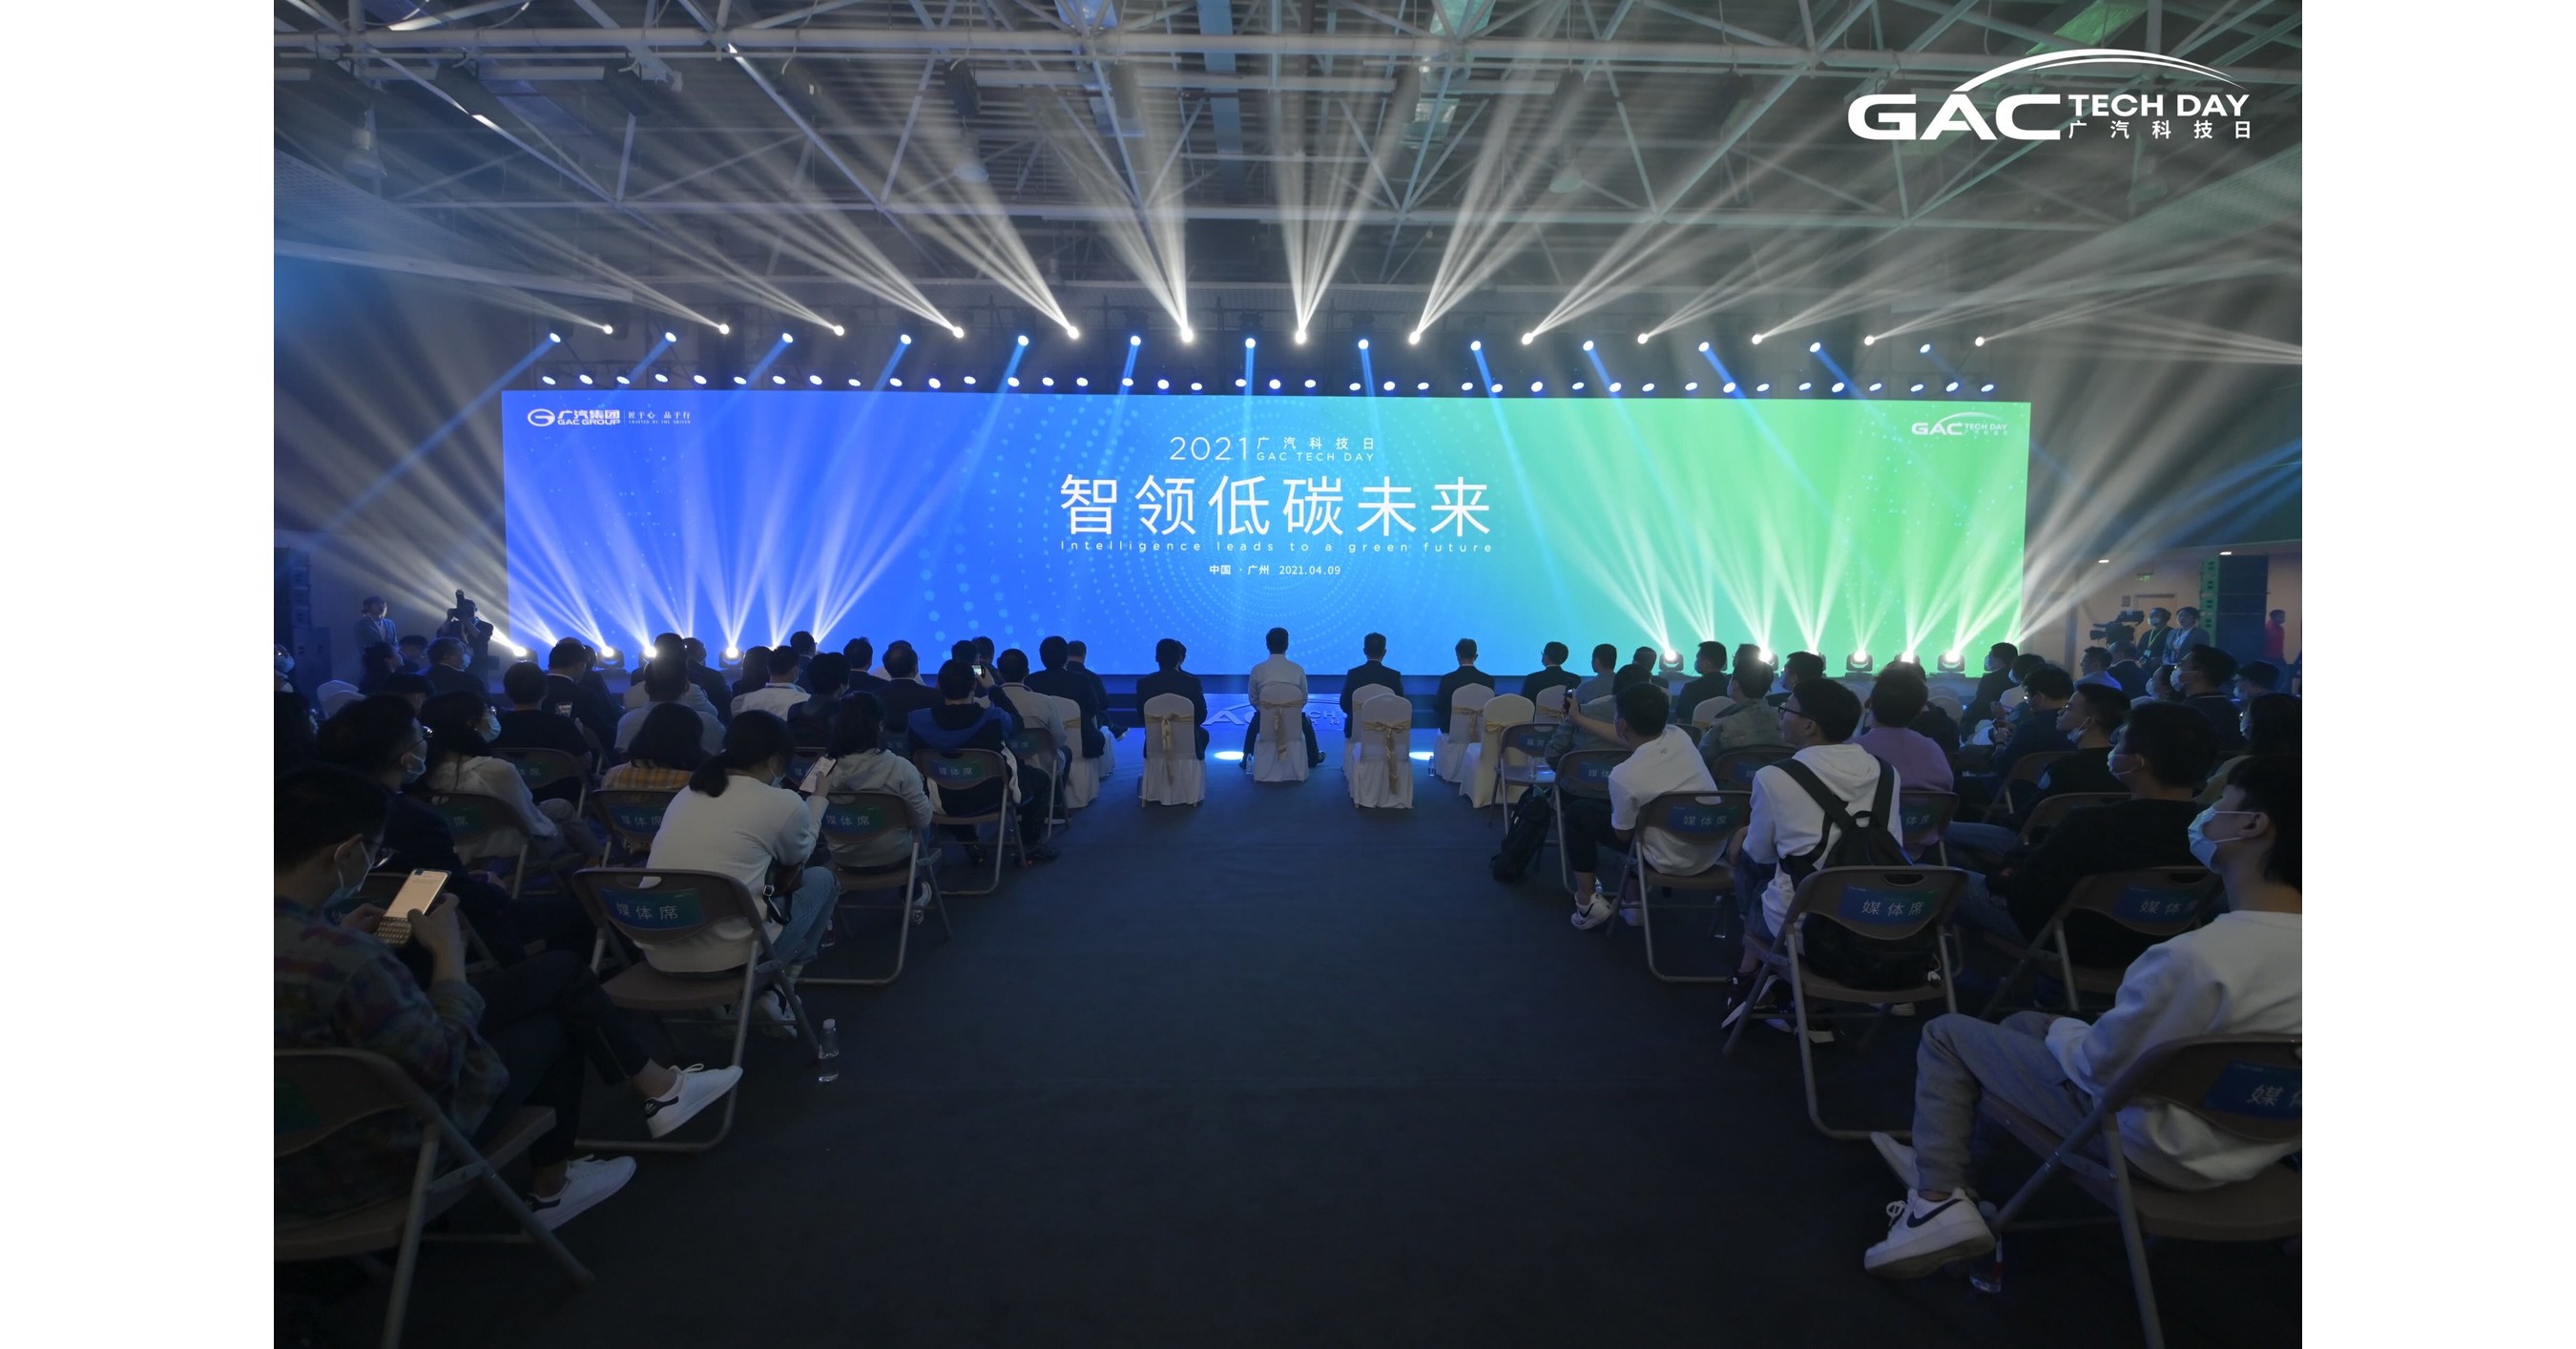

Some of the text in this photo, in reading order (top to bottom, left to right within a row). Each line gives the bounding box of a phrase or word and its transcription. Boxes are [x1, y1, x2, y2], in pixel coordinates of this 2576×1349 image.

[557, 409, 620, 419] 广汽集团
[1911, 422, 1963, 436] GAC
[1170, 436, 1248, 461] 2021
[1257, 436, 1374, 450] 广汽科技日
[1257, 452, 1375, 462] GAC TECH DAY
[1060, 474, 1491, 537] 智领低碳未来
[1060, 540, 1492, 553] Intelligence leads to a green future
[1278, 565, 1341, 576] 2021.04.09
[616, 902, 679, 921] 媒体席
[1860, 899, 1925, 917] 媒体席
